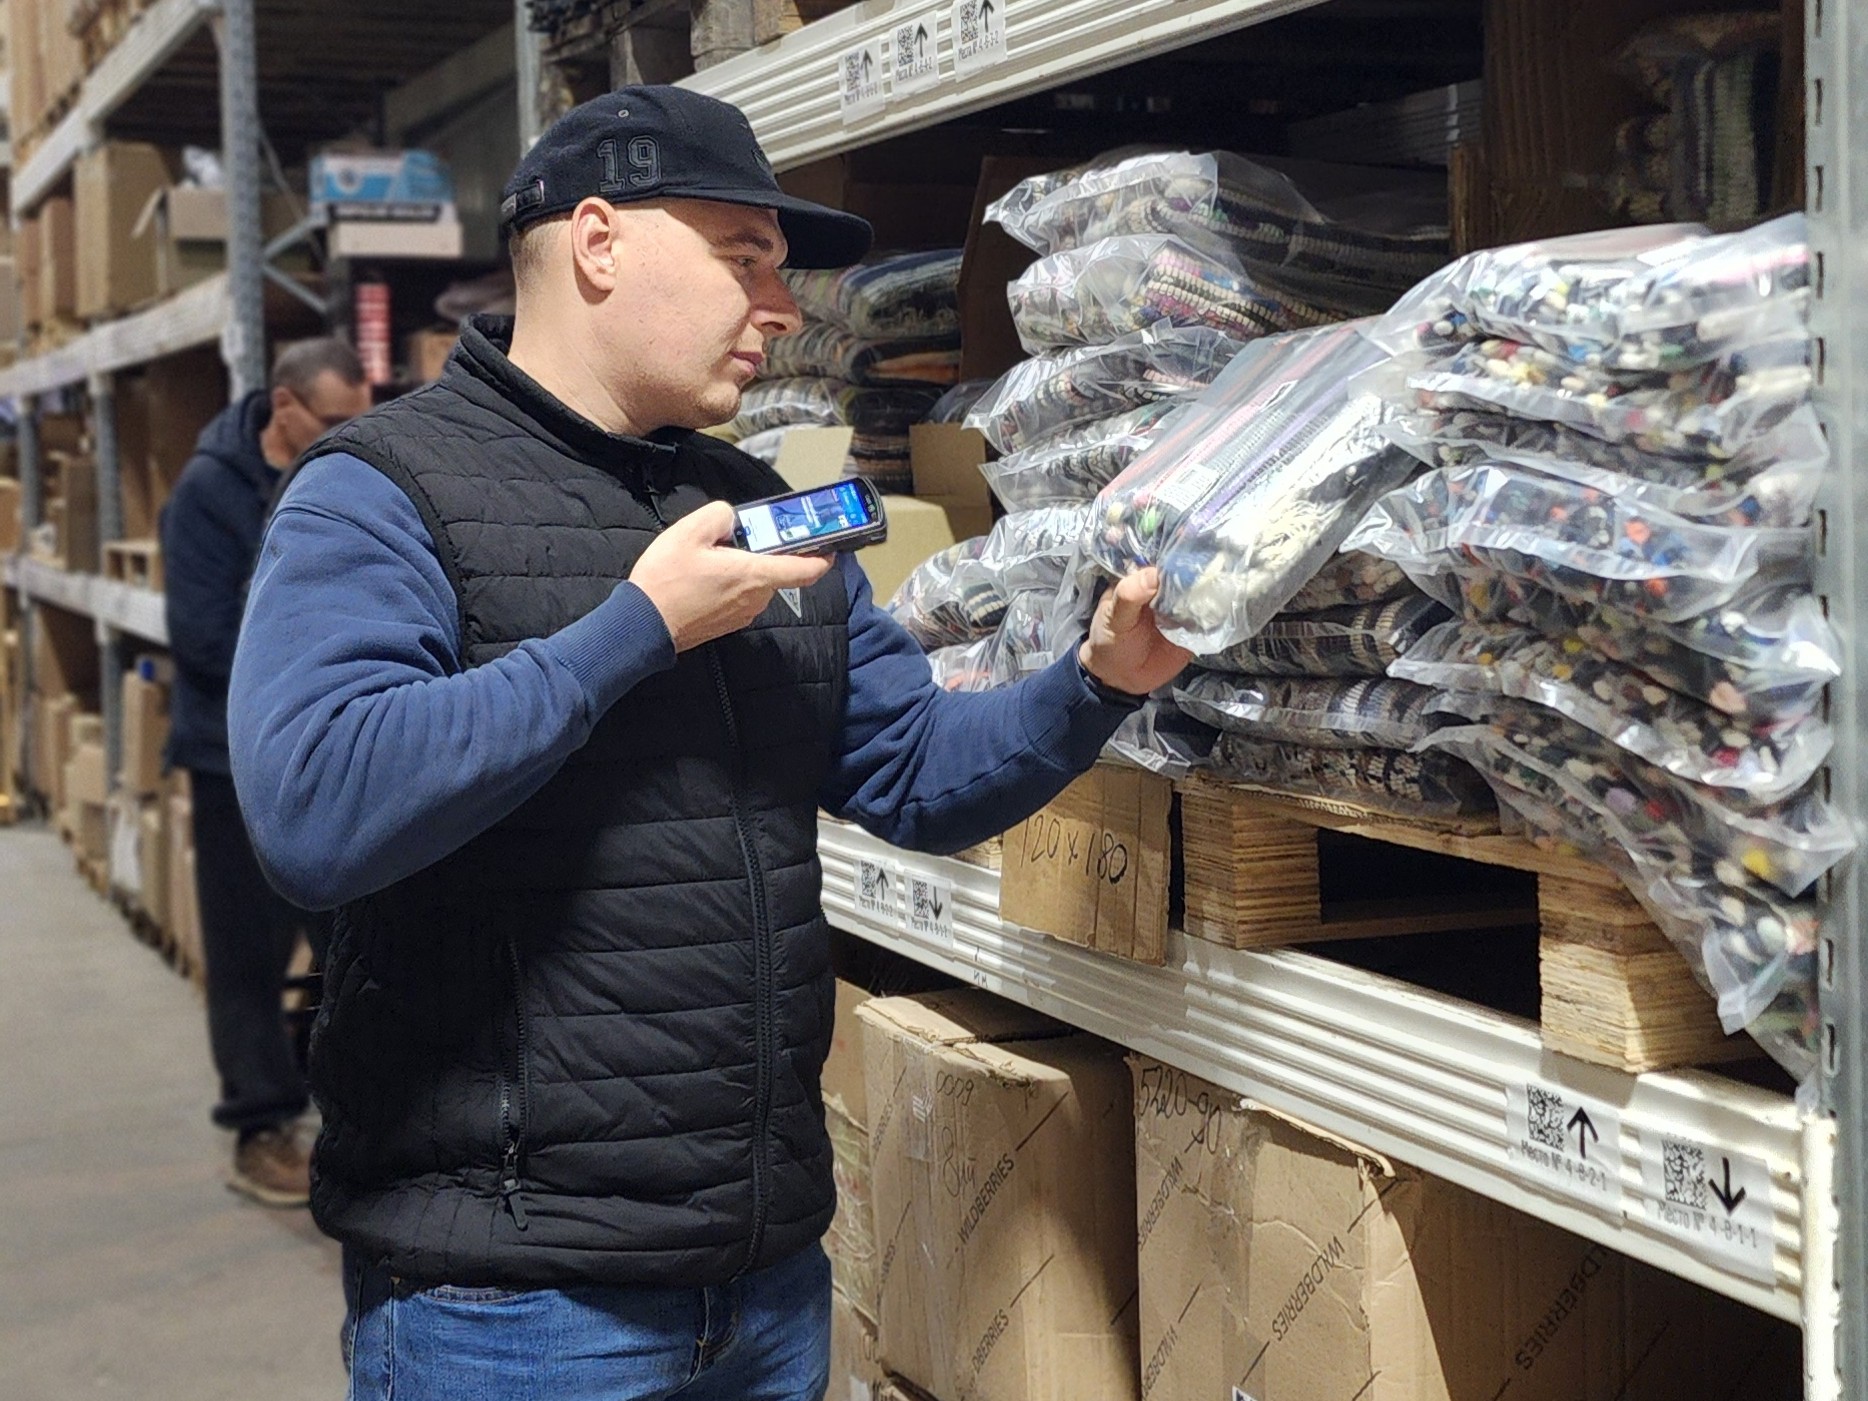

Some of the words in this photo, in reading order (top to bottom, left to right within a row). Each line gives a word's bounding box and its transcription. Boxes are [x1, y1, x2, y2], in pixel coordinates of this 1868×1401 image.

[596, 134, 662, 193] 19
[957, 1152, 1015, 1249] WILDBERRIES
[1564, 1158, 1607, 1191] 4-8-2-1
[1709, 1215, 1757, 1248] 4-8-1-1
[1271, 1235, 1346, 1343] WILDBERRIES
